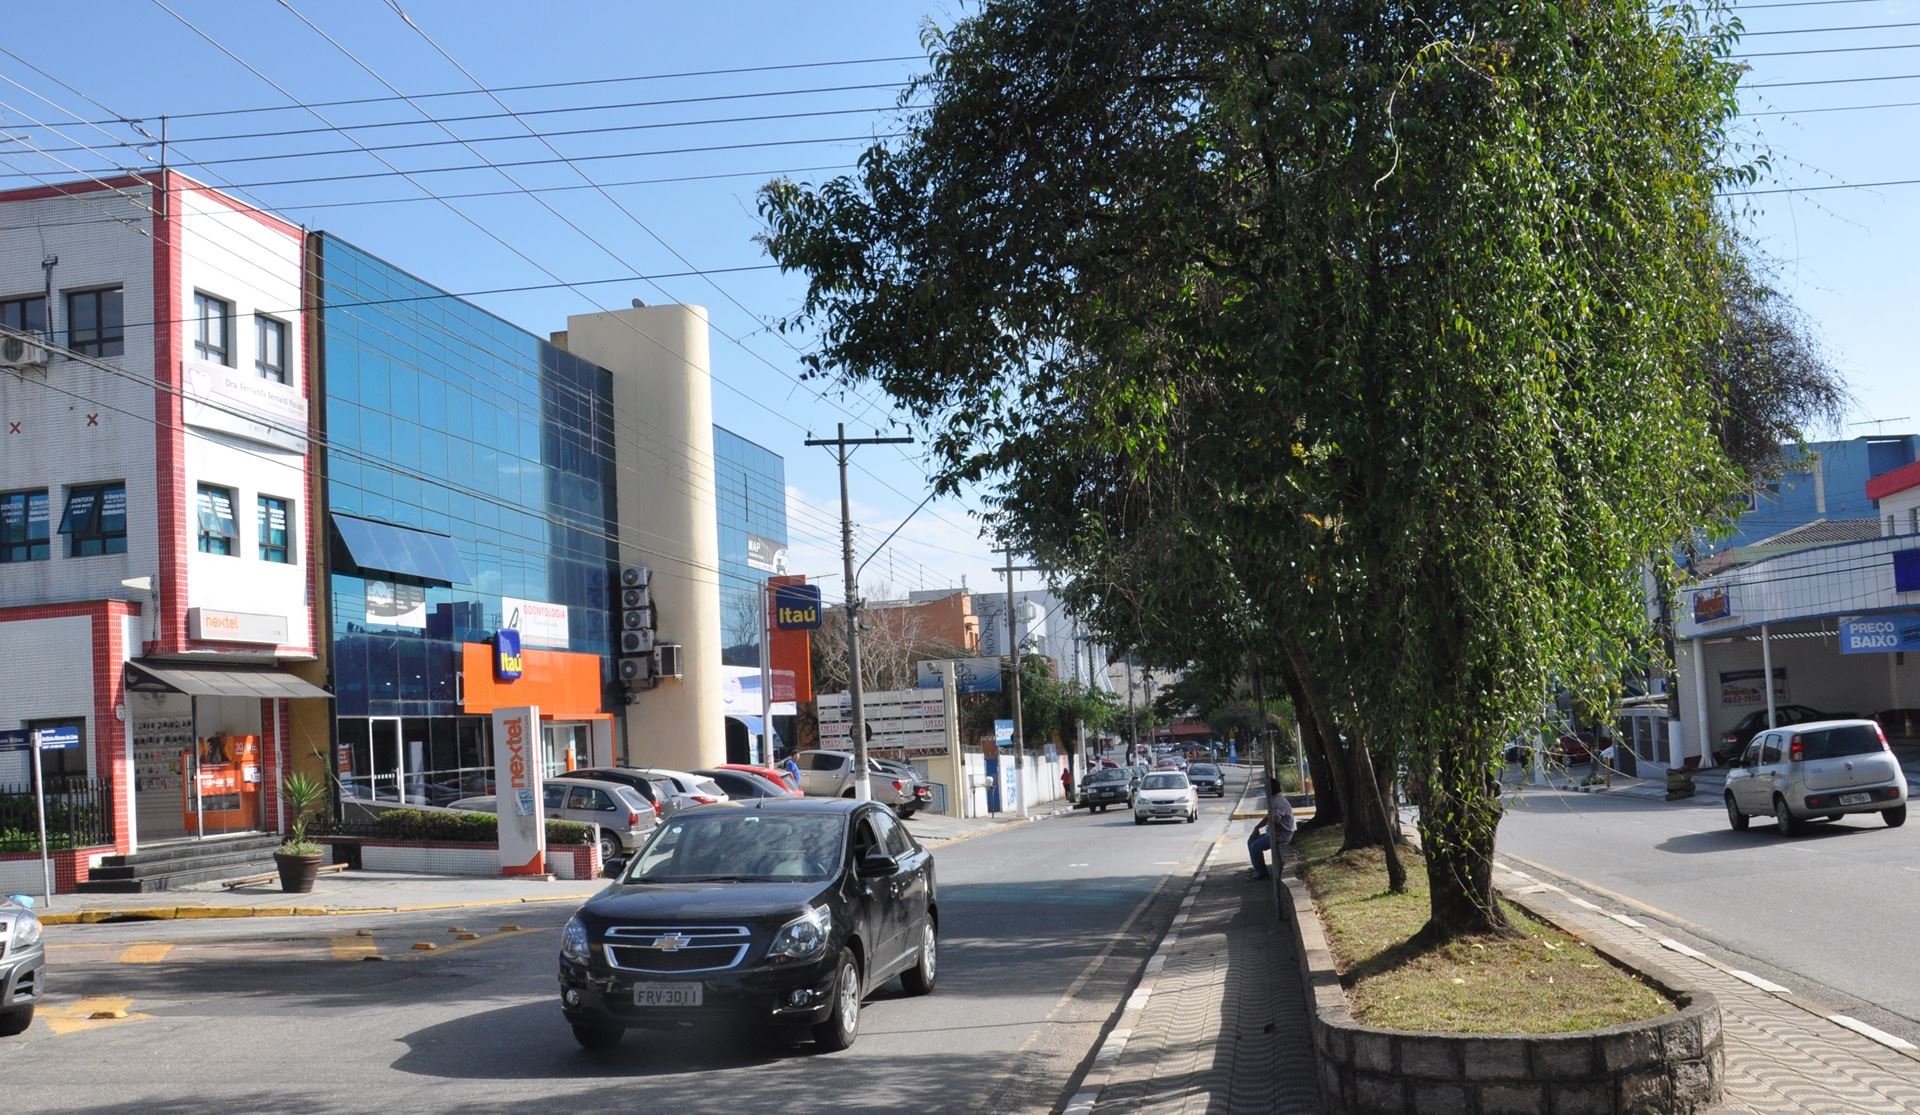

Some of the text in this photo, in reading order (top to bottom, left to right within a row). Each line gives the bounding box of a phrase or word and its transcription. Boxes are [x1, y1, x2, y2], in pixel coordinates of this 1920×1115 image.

[523, 604, 566, 619] ODONTOLOGIA
[779, 605, 816, 624] Itaú
[205, 615, 239, 629] nextel
[1849, 621, 1895, 635] PREÇO
[1850, 634, 1898, 649] BAIXO
[500, 652, 522, 672] Itaú
[503, 717, 525, 789] nextel
